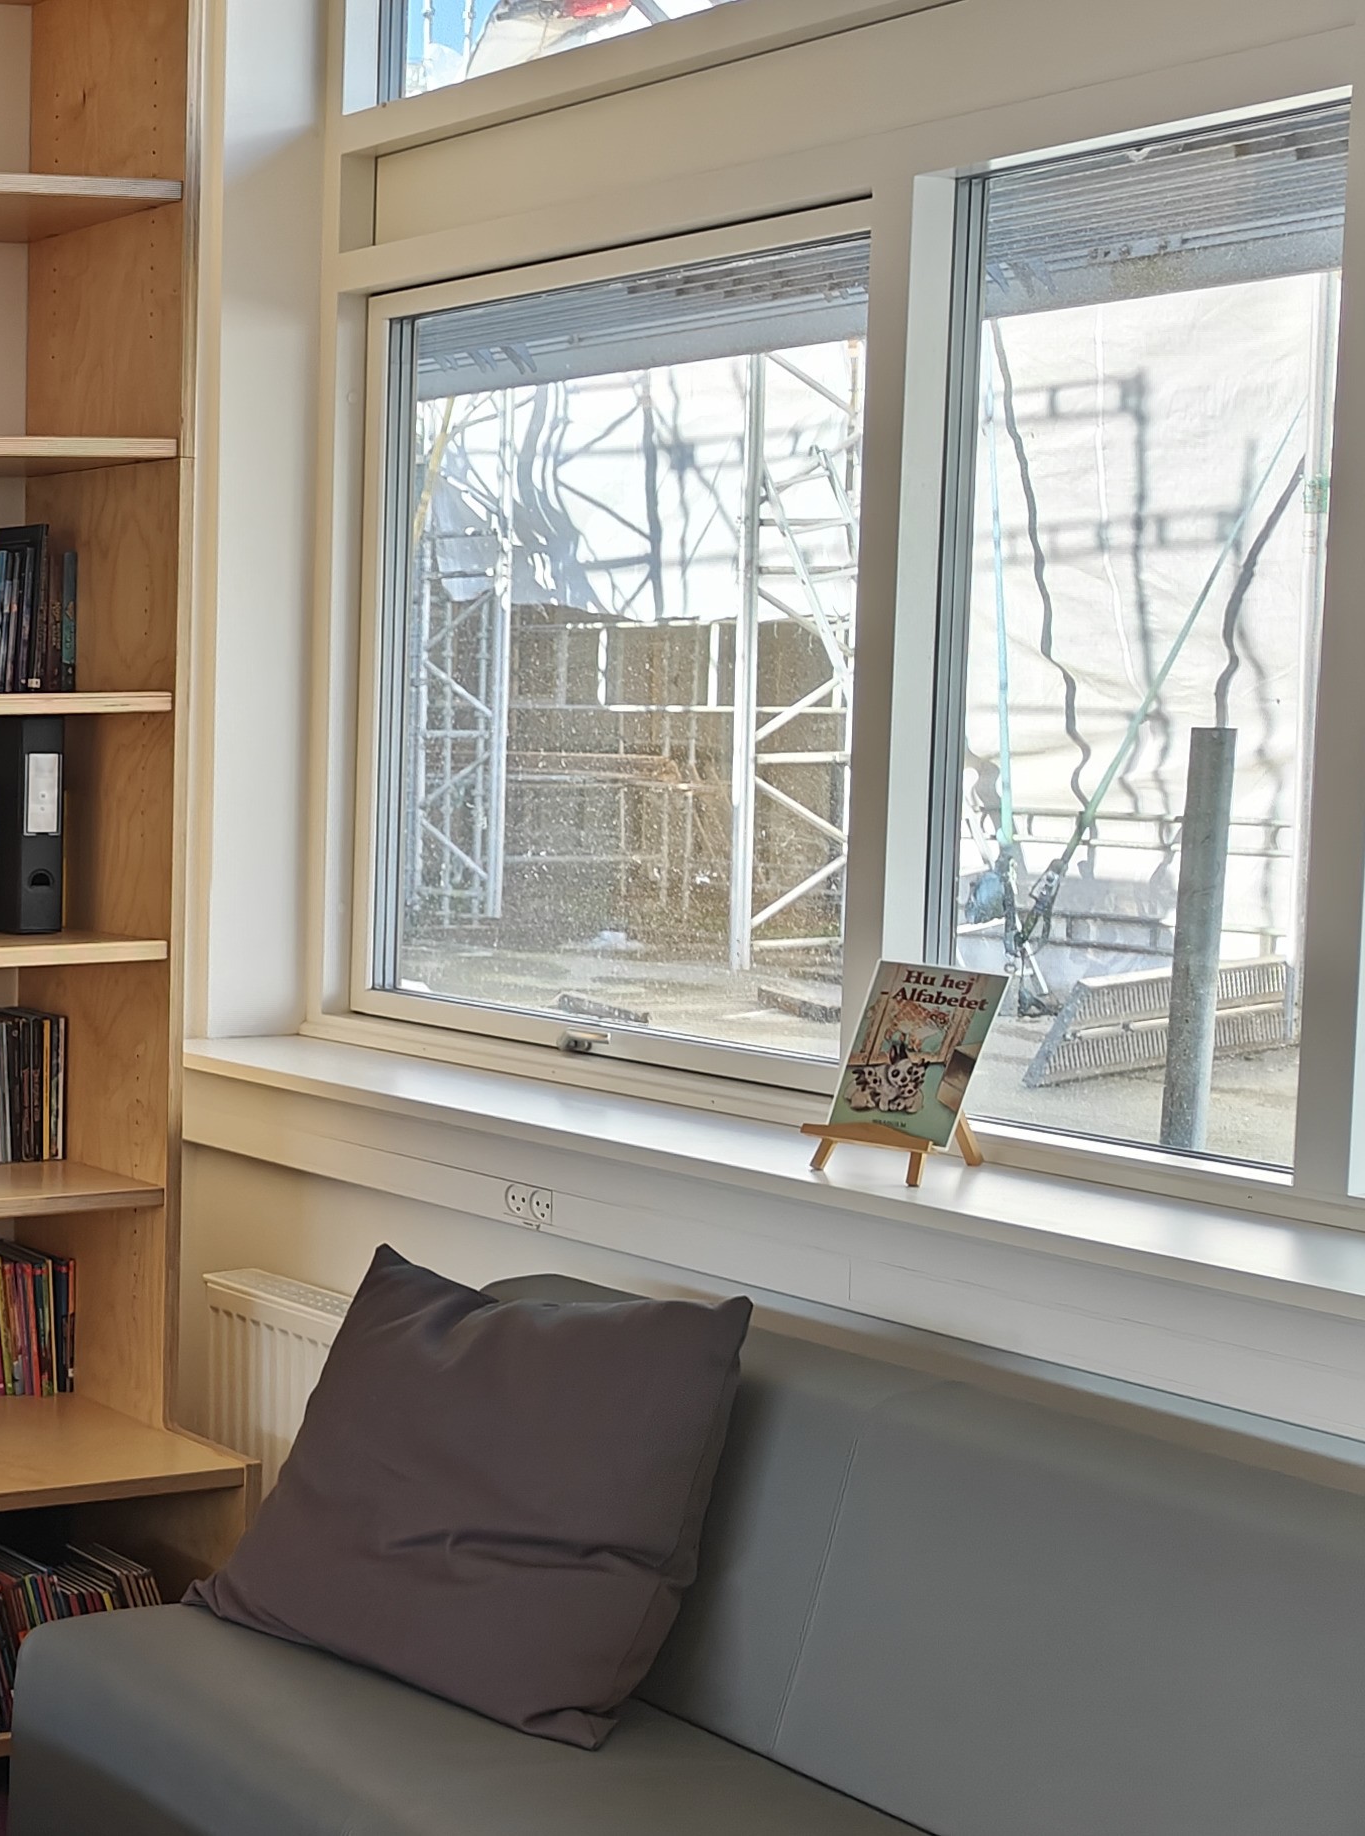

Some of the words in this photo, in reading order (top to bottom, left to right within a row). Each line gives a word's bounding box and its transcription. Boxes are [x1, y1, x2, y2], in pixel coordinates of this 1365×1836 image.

[903, 969, 937, 986] Hu
[941, 974, 975, 995] hej
[892, 986, 989, 1011] Alfabetet
